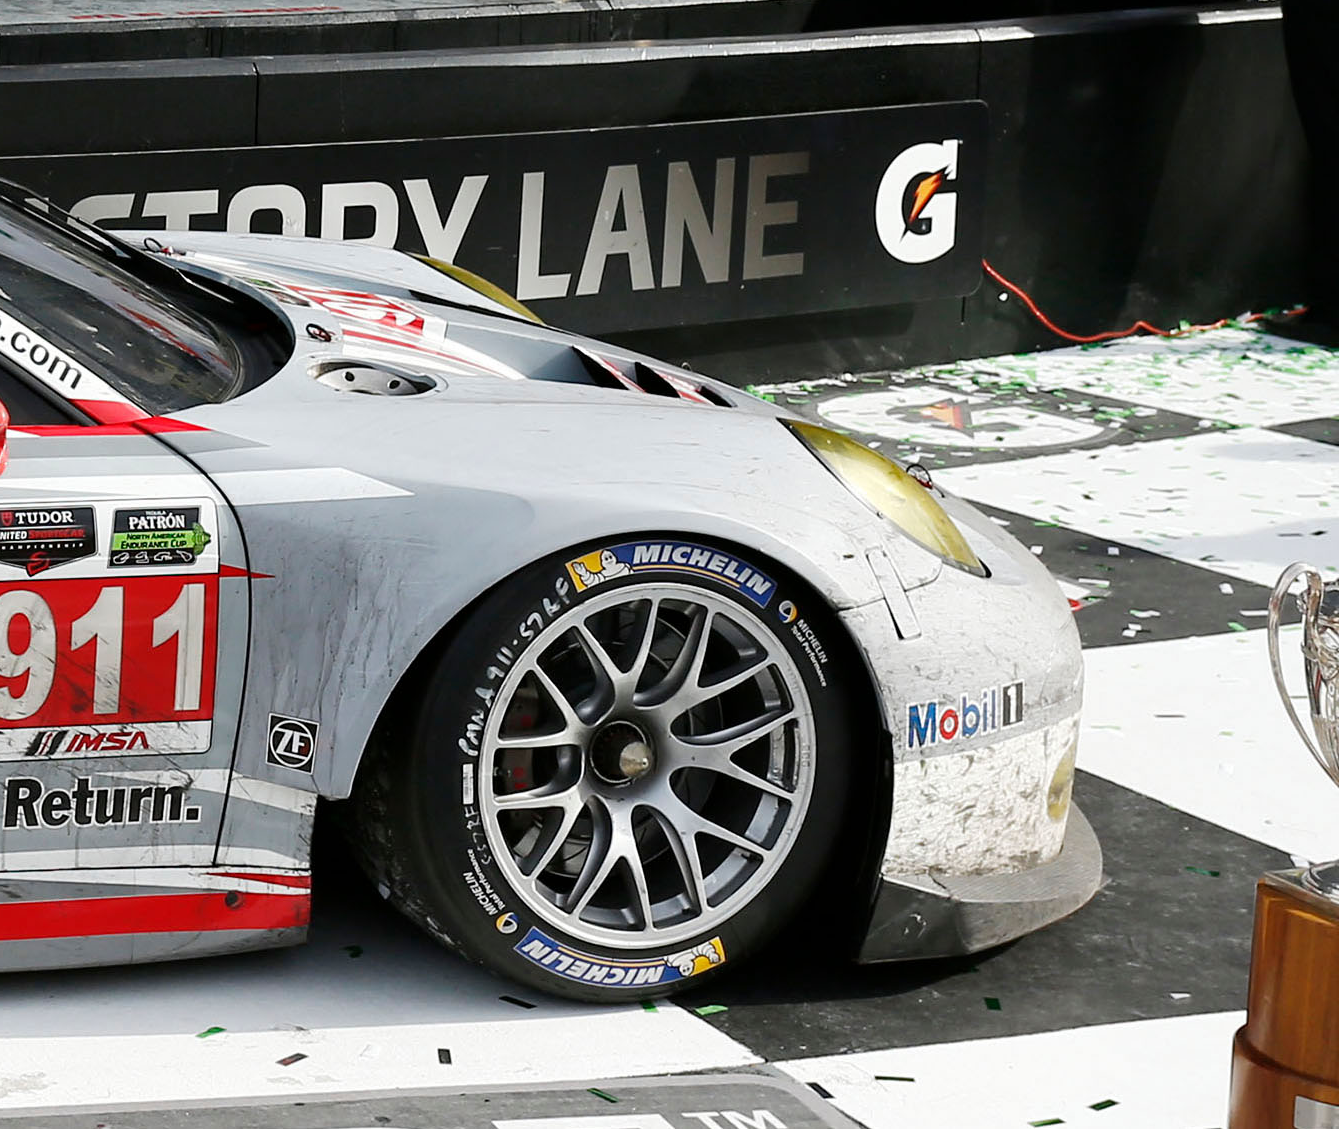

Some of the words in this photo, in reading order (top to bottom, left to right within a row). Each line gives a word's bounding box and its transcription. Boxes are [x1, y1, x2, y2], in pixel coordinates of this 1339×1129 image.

[518, 152, 809, 301] LANE
[14, 510, 74, 525] TUDOR
[28, 528, 86, 540] SPORTSCAR
[127, 512, 187, 531] PATRÓN
[120, 539, 169, 550] ENDURANCE
[170, 538, 188, 549] CUP
[632, 543, 775, 598] MICHELIN
[790, 625, 810, 650] Total
[802, 641, 829, 688] Performance
[796, 617, 829, 666] MICHELIN
[907, 688, 999, 750] Mobil
[1003, 683, 1022, 724] 1
[65, 731, 151, 753] IMSA
[274, 727, 316, 760] ZF
[2, 777, 203, 831] Return.
[461, 870, 499, 917] MICHELIN
[468, 847, 495, 895] Performance
[487, 886, 508, 913] Total
[522, 938, 667, 988] MICHELIN
